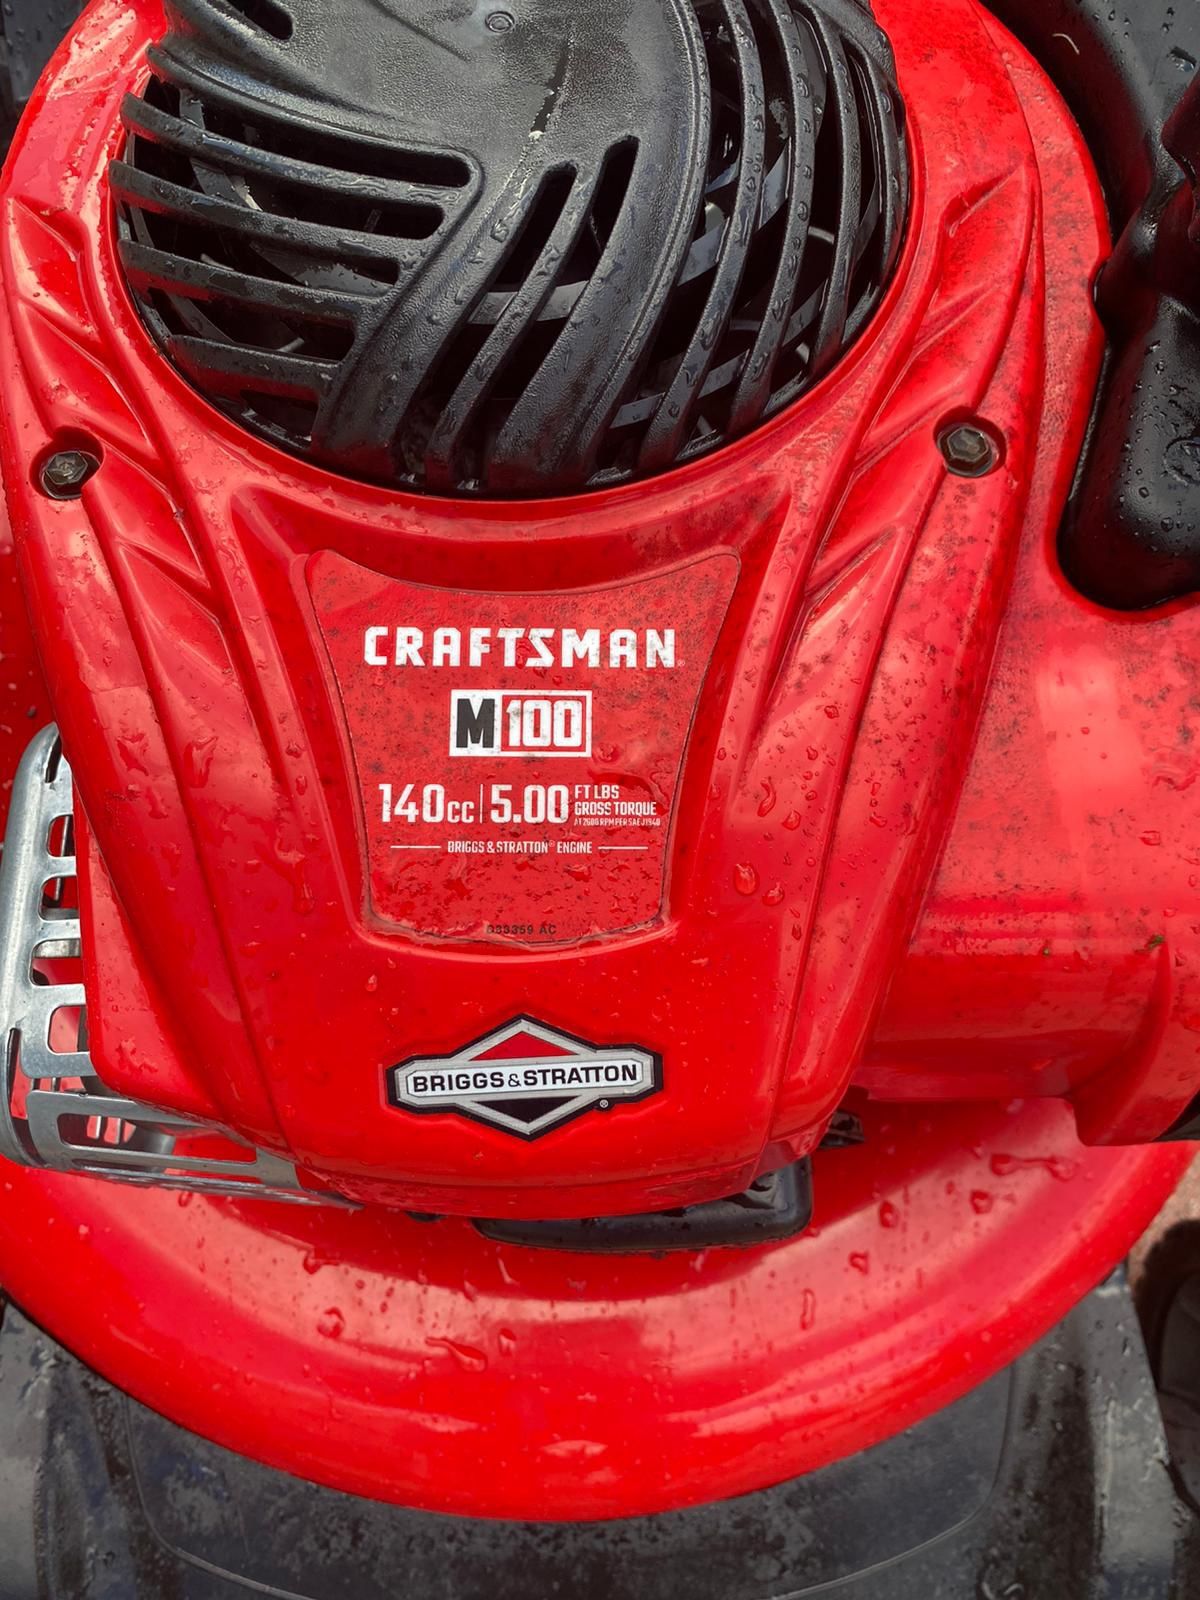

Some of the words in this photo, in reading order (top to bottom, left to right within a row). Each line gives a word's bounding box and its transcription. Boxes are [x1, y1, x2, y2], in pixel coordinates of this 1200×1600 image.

[364, 626, 675, 668] CRAFTSMAN
[378, 783, 475, 823] 140cc
[490, 784, 569, 824] 5.00
[574, 784, 590, 799] FT
[594, 784, 620, 799] LBS
[574, 801, 612, 816] GROSS
[613, 801, 657, 817] TORQUE
[447, 840, 485, 853] BRIGGS
[496, 841, 548, 854] STRATTON
[556, 841, 592, 854] ENGINE
